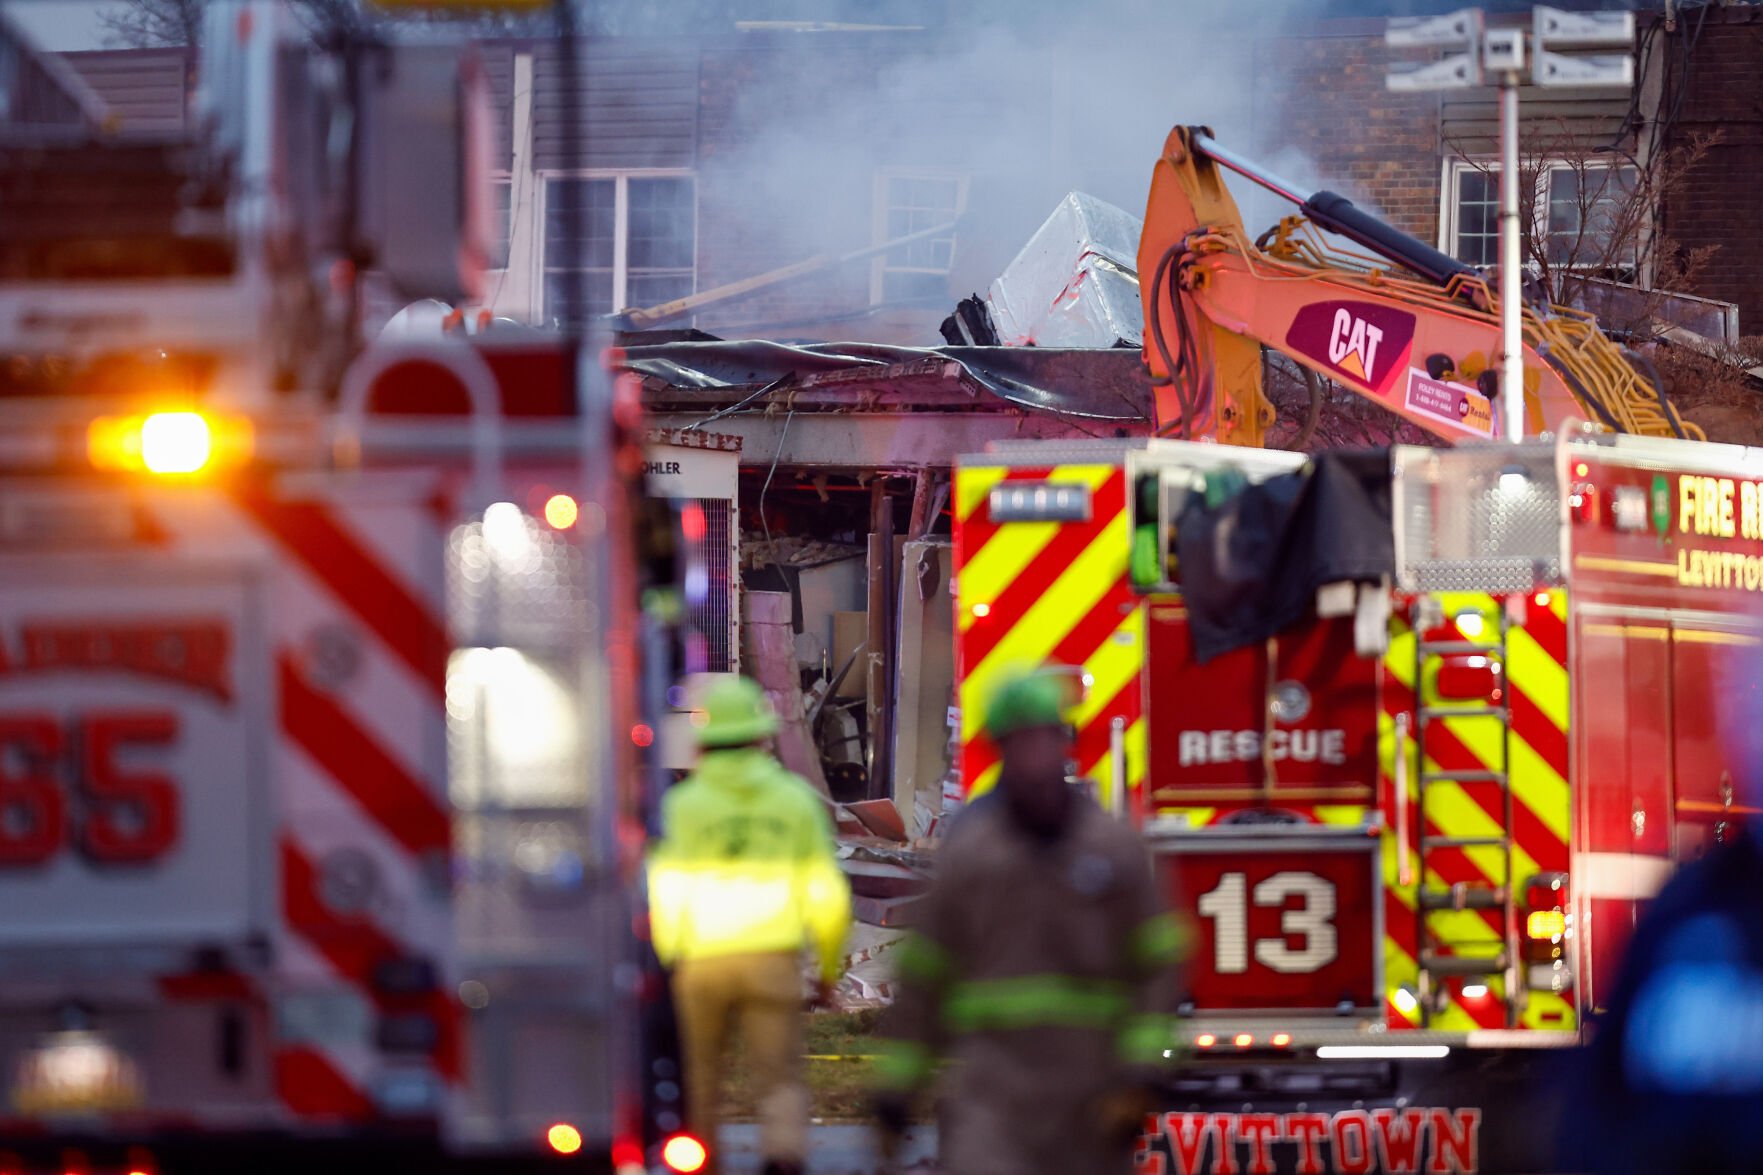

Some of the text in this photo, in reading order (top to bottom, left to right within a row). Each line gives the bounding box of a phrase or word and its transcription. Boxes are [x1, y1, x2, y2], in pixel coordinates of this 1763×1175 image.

[1328, 307, 1383, 383] CAT
[641, 461, 681, 475] OHLER
[1679, 474, 1735, 538] FIRE
[1678, 548, 1763, 592] LEVITTO
[1178, 729, 1346, 767] RESCUE
[1198, 871, 1337, 973] 13
[1135, 1107, 1482, 1175] EVITTOWN
